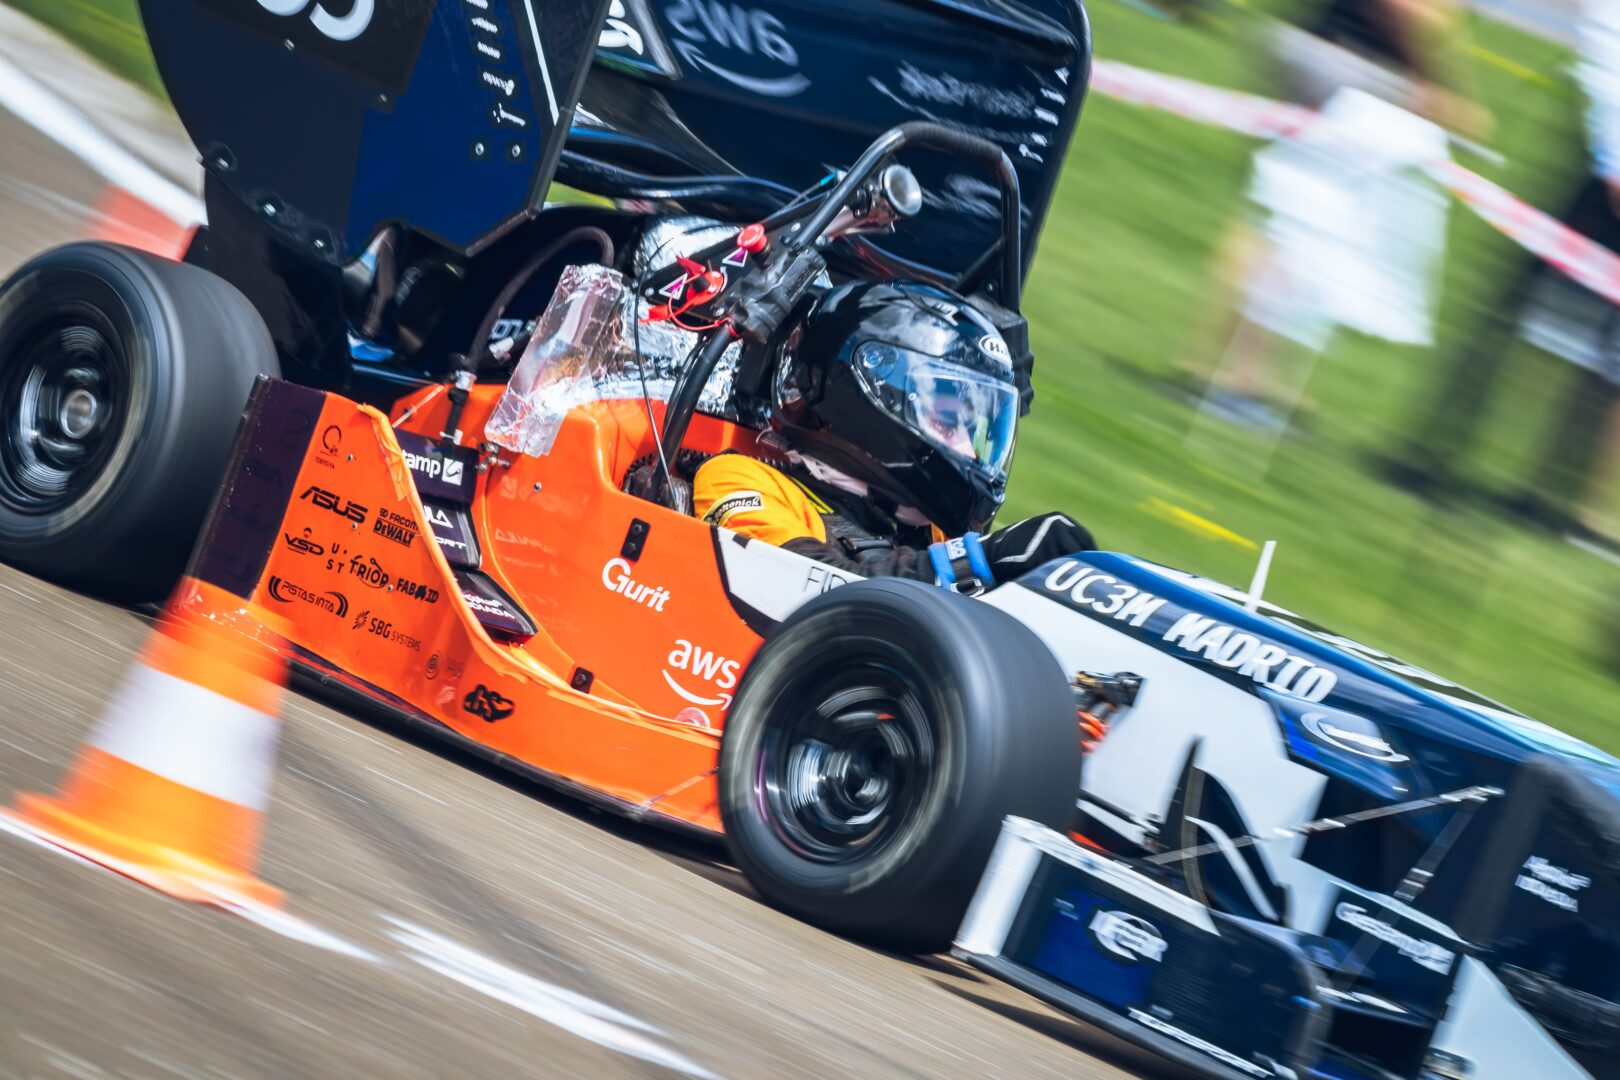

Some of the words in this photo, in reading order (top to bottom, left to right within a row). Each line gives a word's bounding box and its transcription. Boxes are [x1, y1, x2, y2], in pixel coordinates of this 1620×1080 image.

[300, 485, 369, 524] ASUS
[280, 581, 316, 604] PISTAS
[602, 557, 670, 612] Gurit
[368, 617, 392, 639] SBG
[1044, 560, 1168, 627] UC3M
[1162, 612, 1338, 703] MADRID
[667, 639, 740, 689] aws
